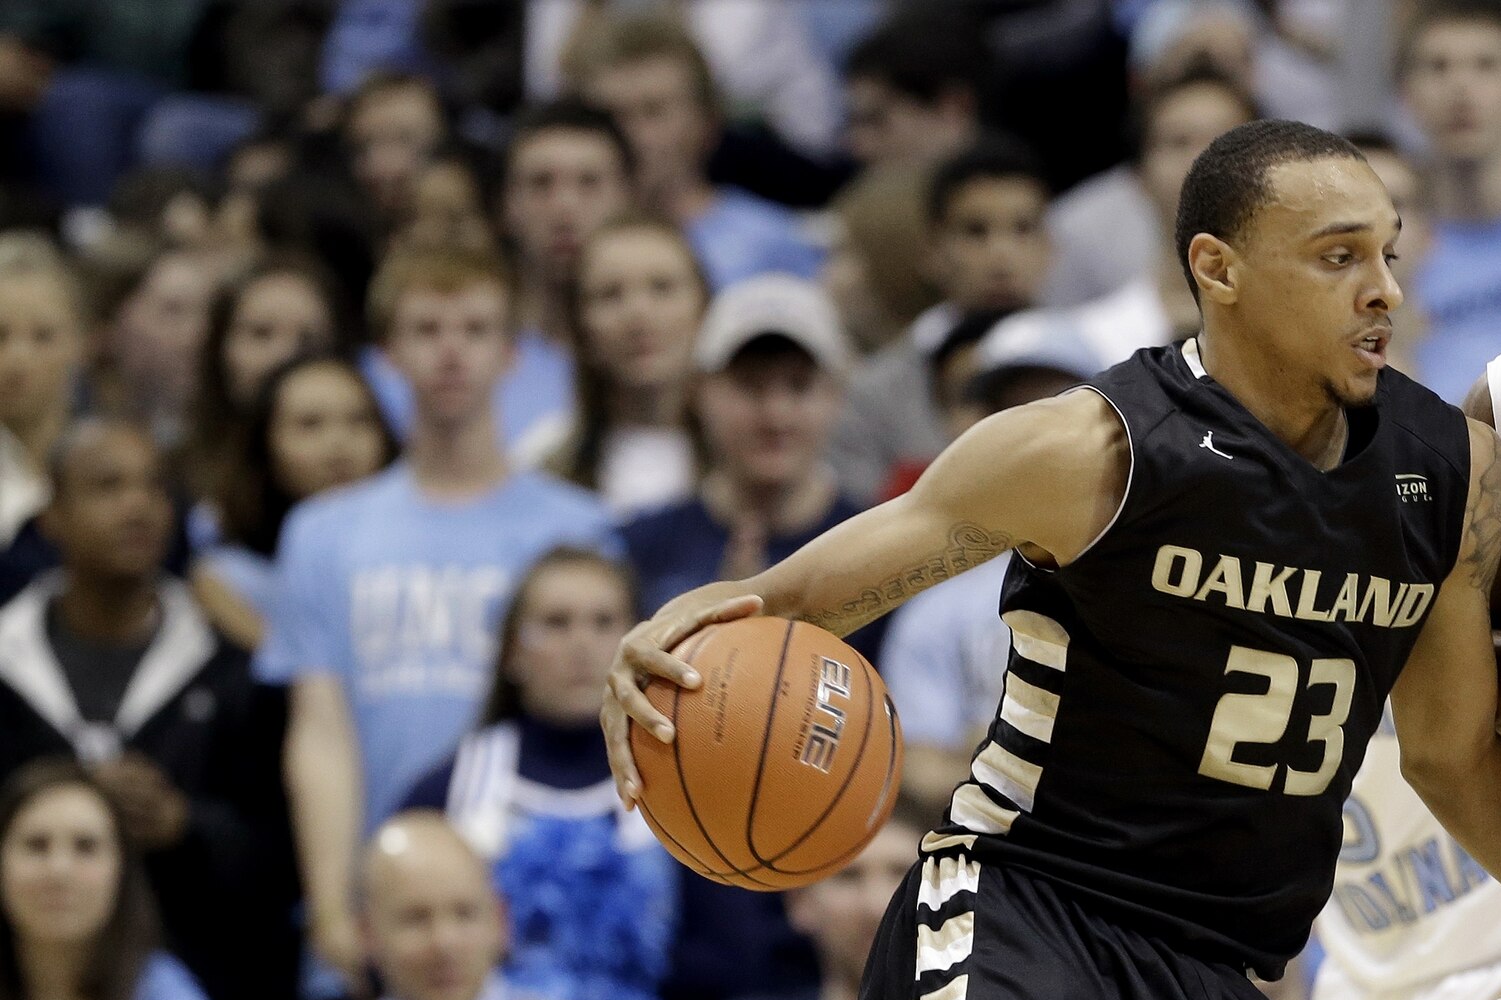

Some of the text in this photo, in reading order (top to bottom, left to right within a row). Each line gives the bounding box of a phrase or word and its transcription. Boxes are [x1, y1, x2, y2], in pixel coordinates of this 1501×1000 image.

[1151, 545, 1434, 628] OAKLAND
[799, 655, 851, 775] ELITE
[1197, 644, 1356, 797] 23
